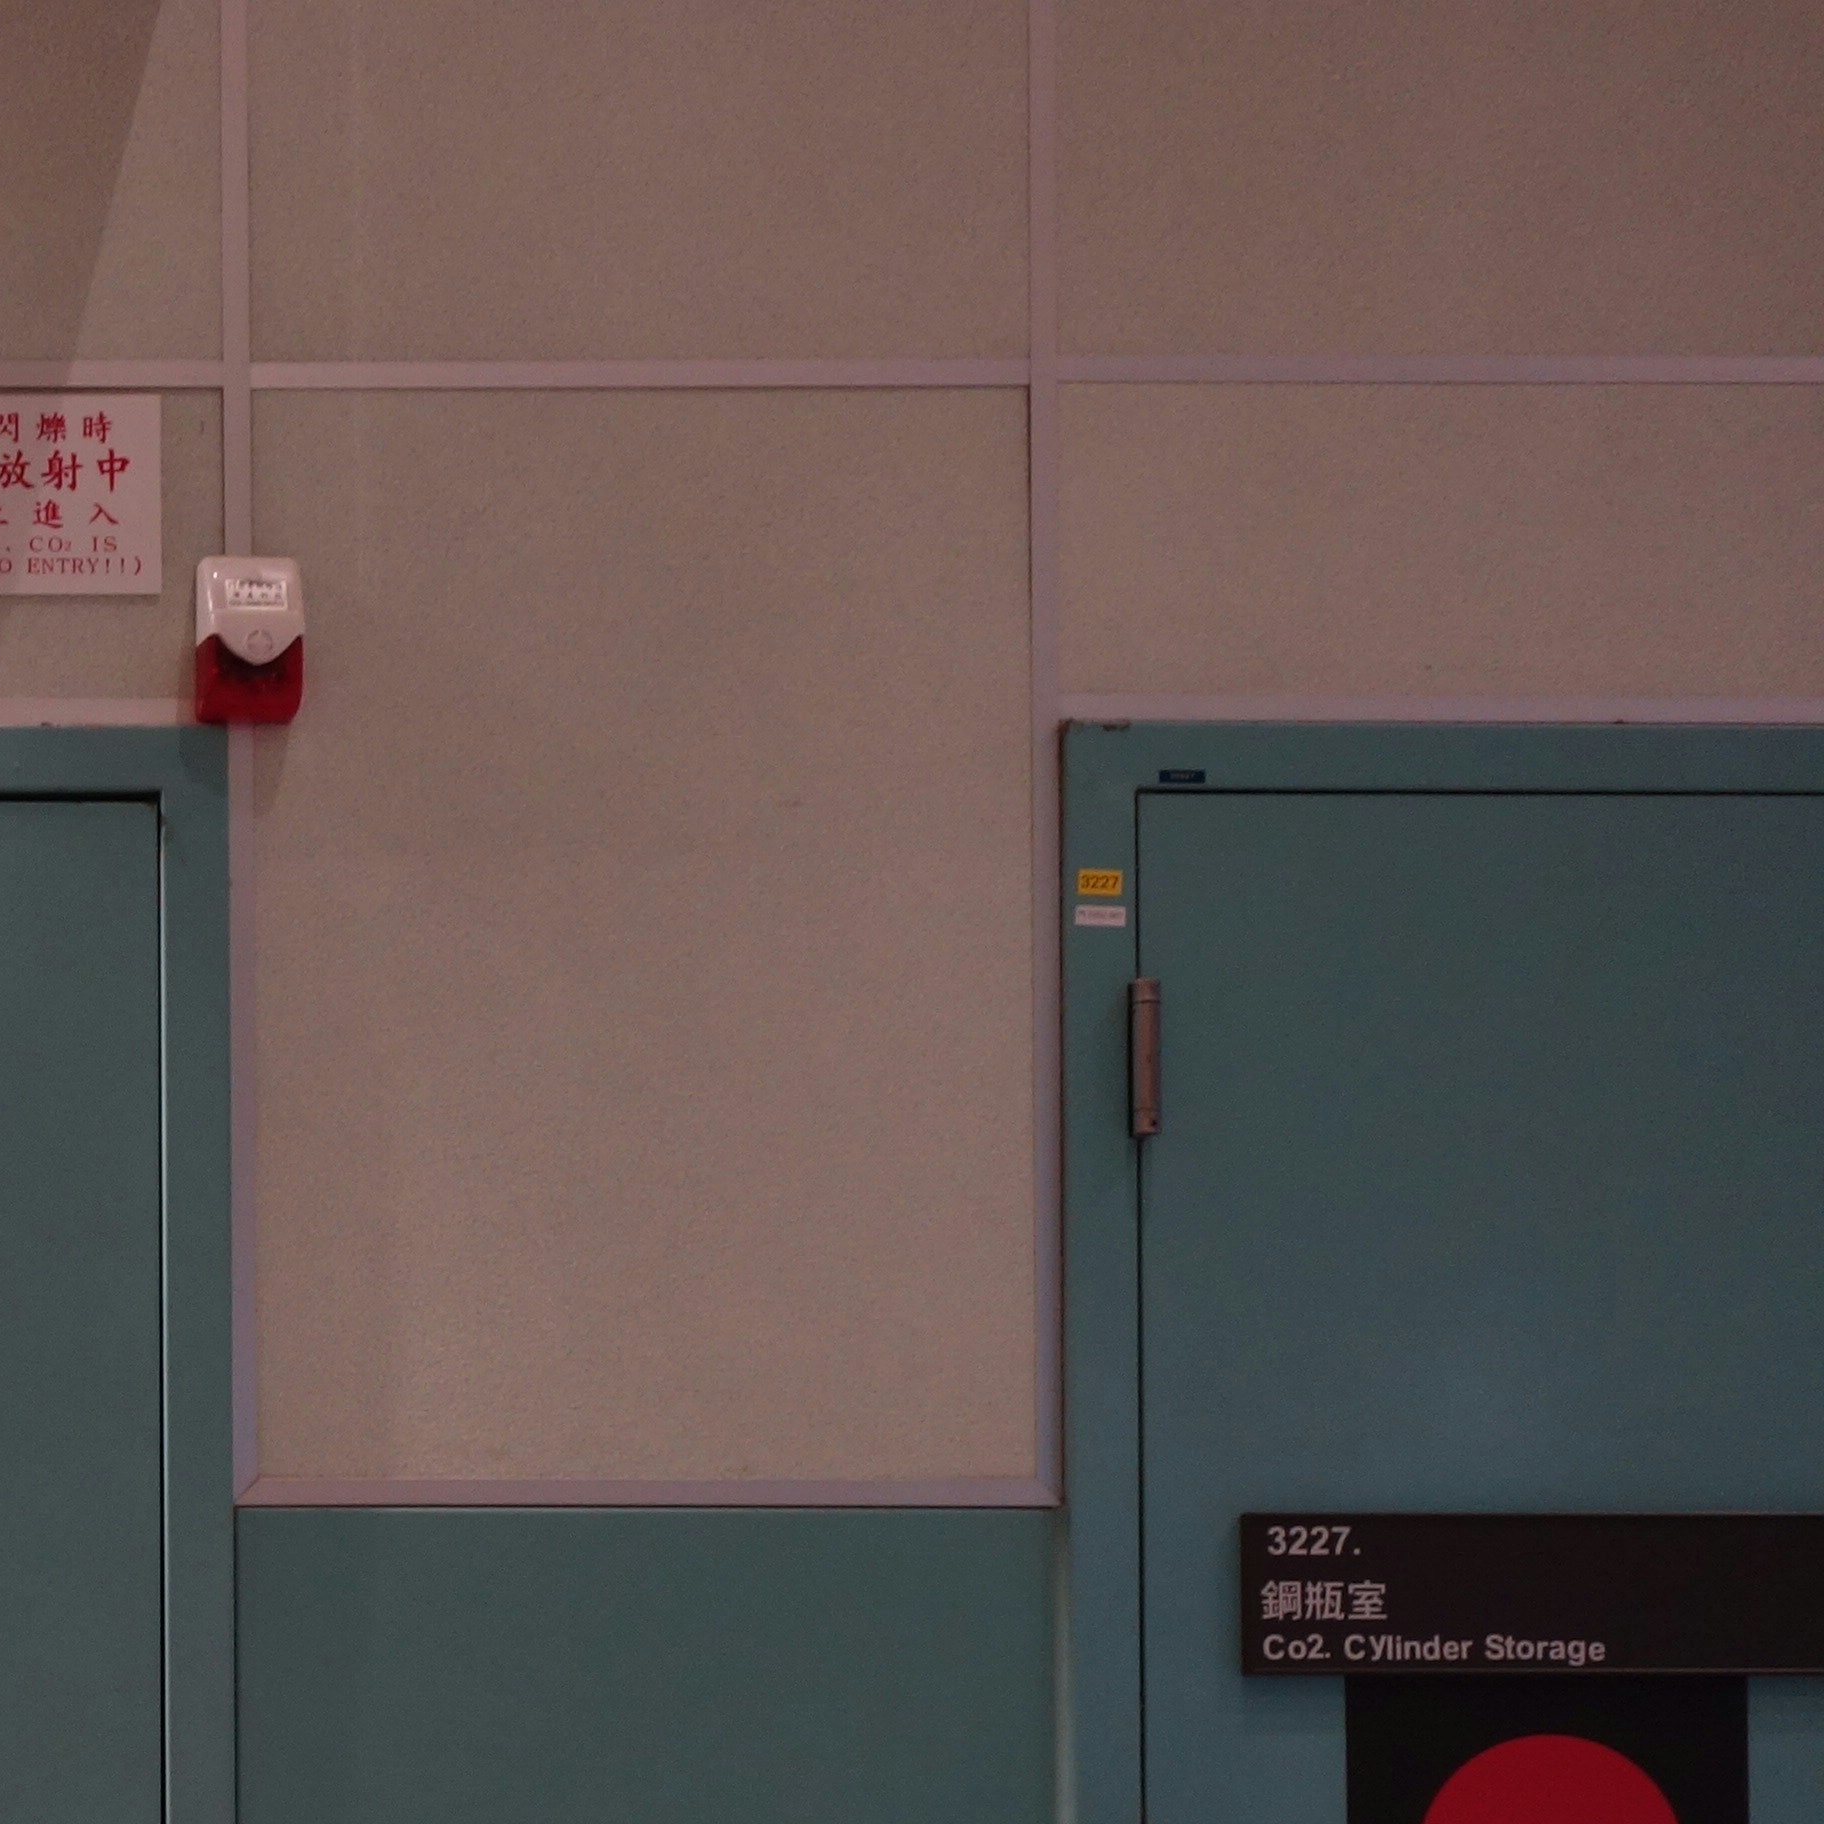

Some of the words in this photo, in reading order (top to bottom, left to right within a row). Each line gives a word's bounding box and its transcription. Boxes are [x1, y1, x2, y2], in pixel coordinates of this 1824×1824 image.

[92, 536, 118, 552] IS
[1080, 874, 1119, 890] 3227
[1267, 1526, 1362, 1556] 3227.
[1260, 1580, 1388, 1621] 鋼瓶室
[1262, 1634, 1331, 1661] Co2.
[1484, 1634, 1607, 1667] Storage
